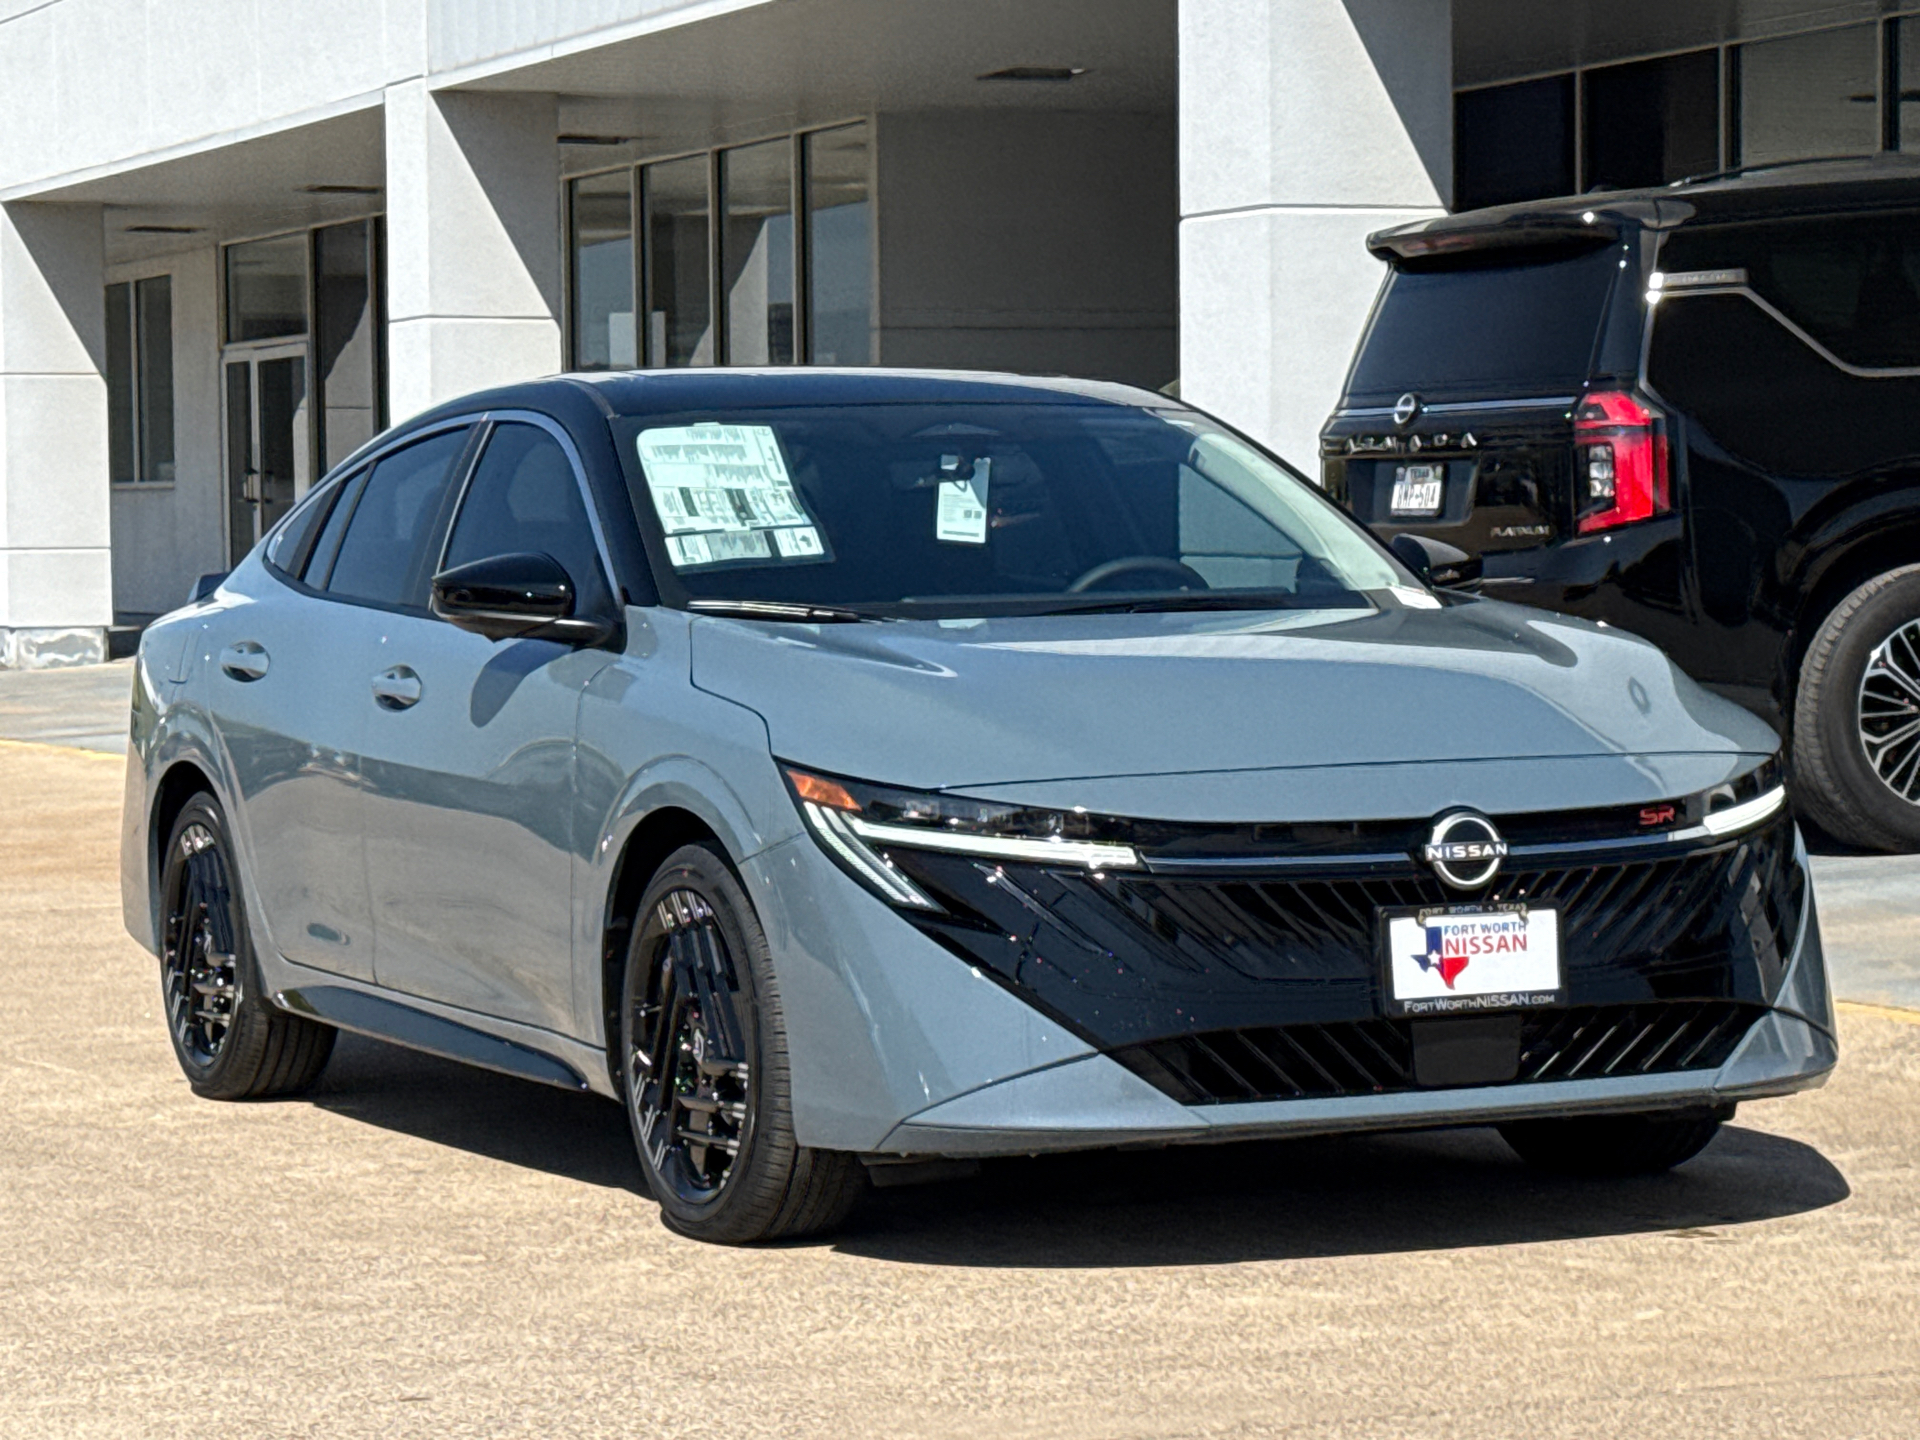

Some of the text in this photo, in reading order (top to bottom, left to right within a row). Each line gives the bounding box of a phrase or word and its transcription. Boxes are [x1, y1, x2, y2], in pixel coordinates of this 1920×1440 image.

[1639, 804, 1675, 825] SR
[1427, 843, 1508, 860] NISSAN
[1419, 903, 1527, 918] FORT WORTH TEXAS
[1444, 921, 1527, 936] FORT WORTH
[1445, 933, 1528, 956] NISSAN
